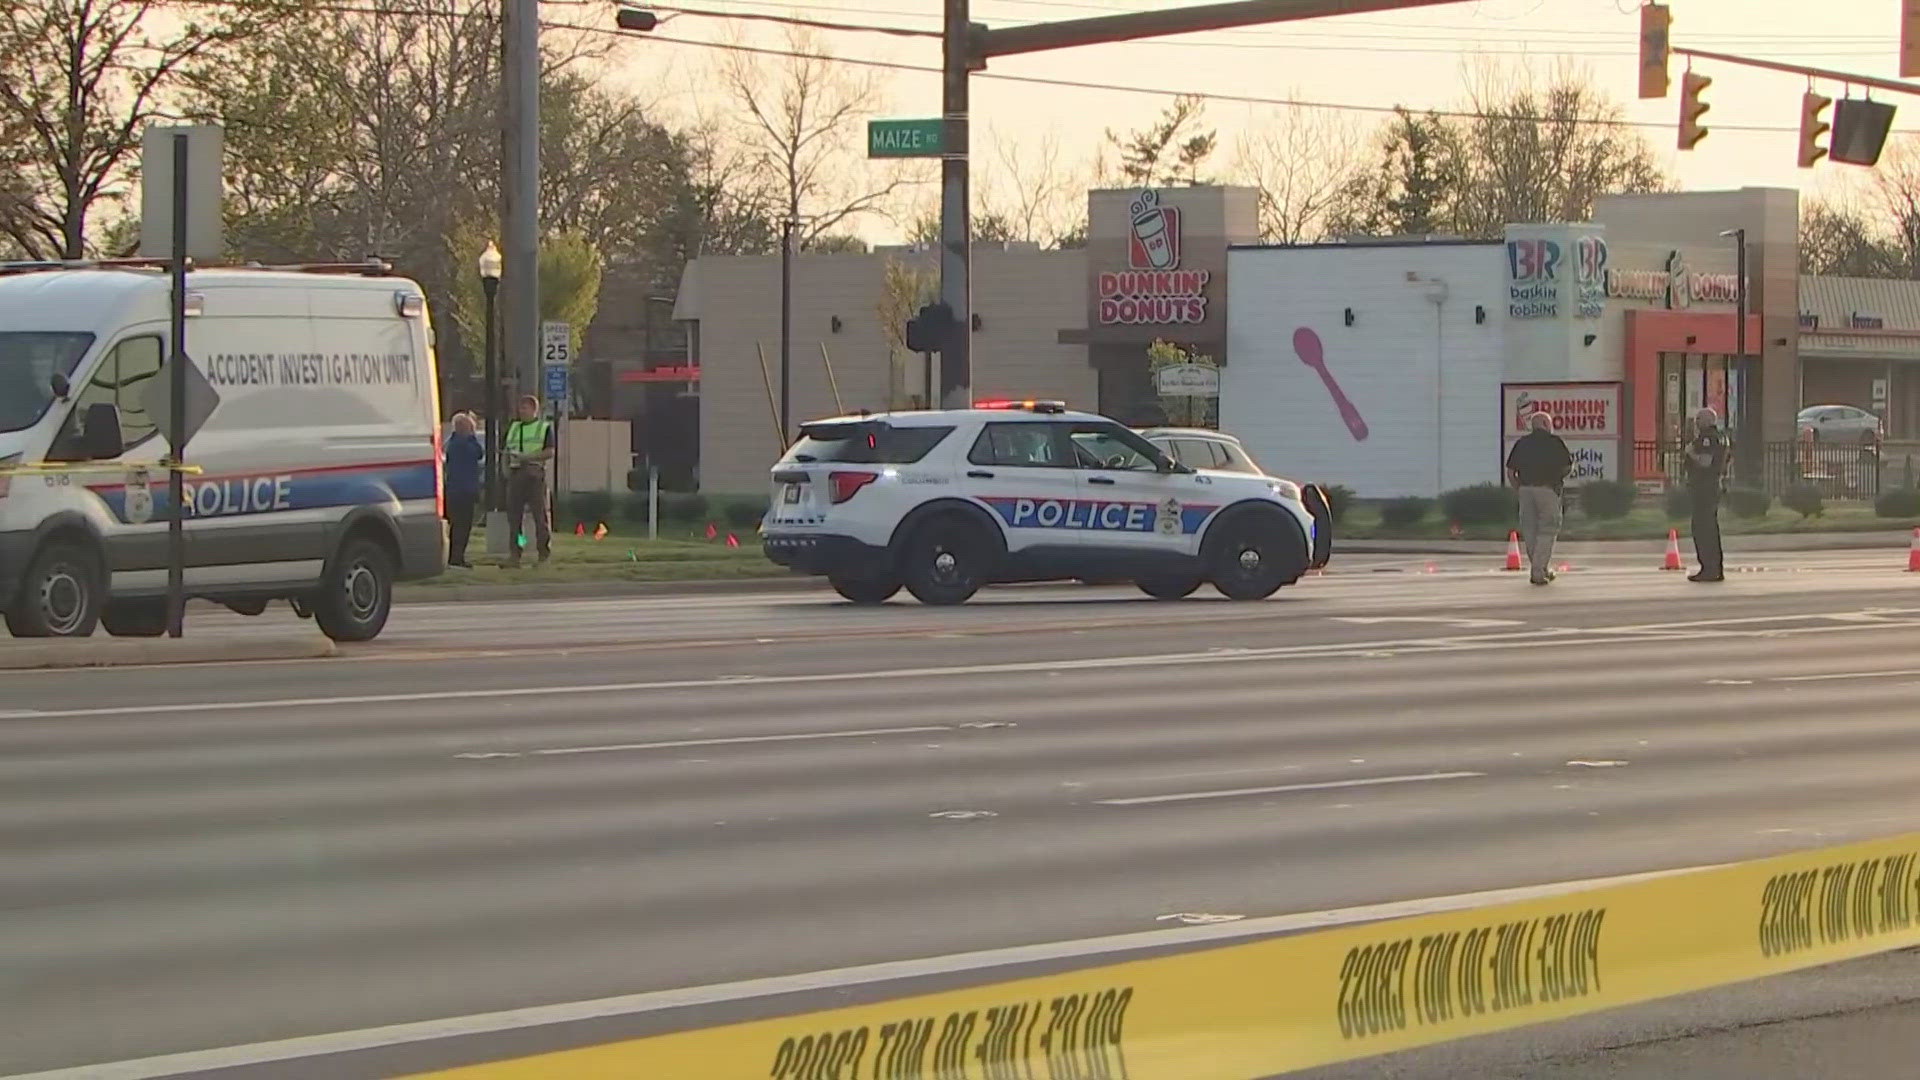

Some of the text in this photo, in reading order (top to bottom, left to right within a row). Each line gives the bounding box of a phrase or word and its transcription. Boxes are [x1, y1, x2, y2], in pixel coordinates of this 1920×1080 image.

[872, 130, 921, 149] MAIZE
[1507, 239, 1561, 280] BR
[1101, 271, 1207, 296] DUNKIN'
[1101, 299, 1203, 322] DONUTS
[546, 344, 568, 360] 25
[207, 353, 410, 385] ACCIDENT INVESTIGATION UNIT
[1551, 415, 1606, 430] ONUTS
[1013, 498, 1147, 529] POLICE
